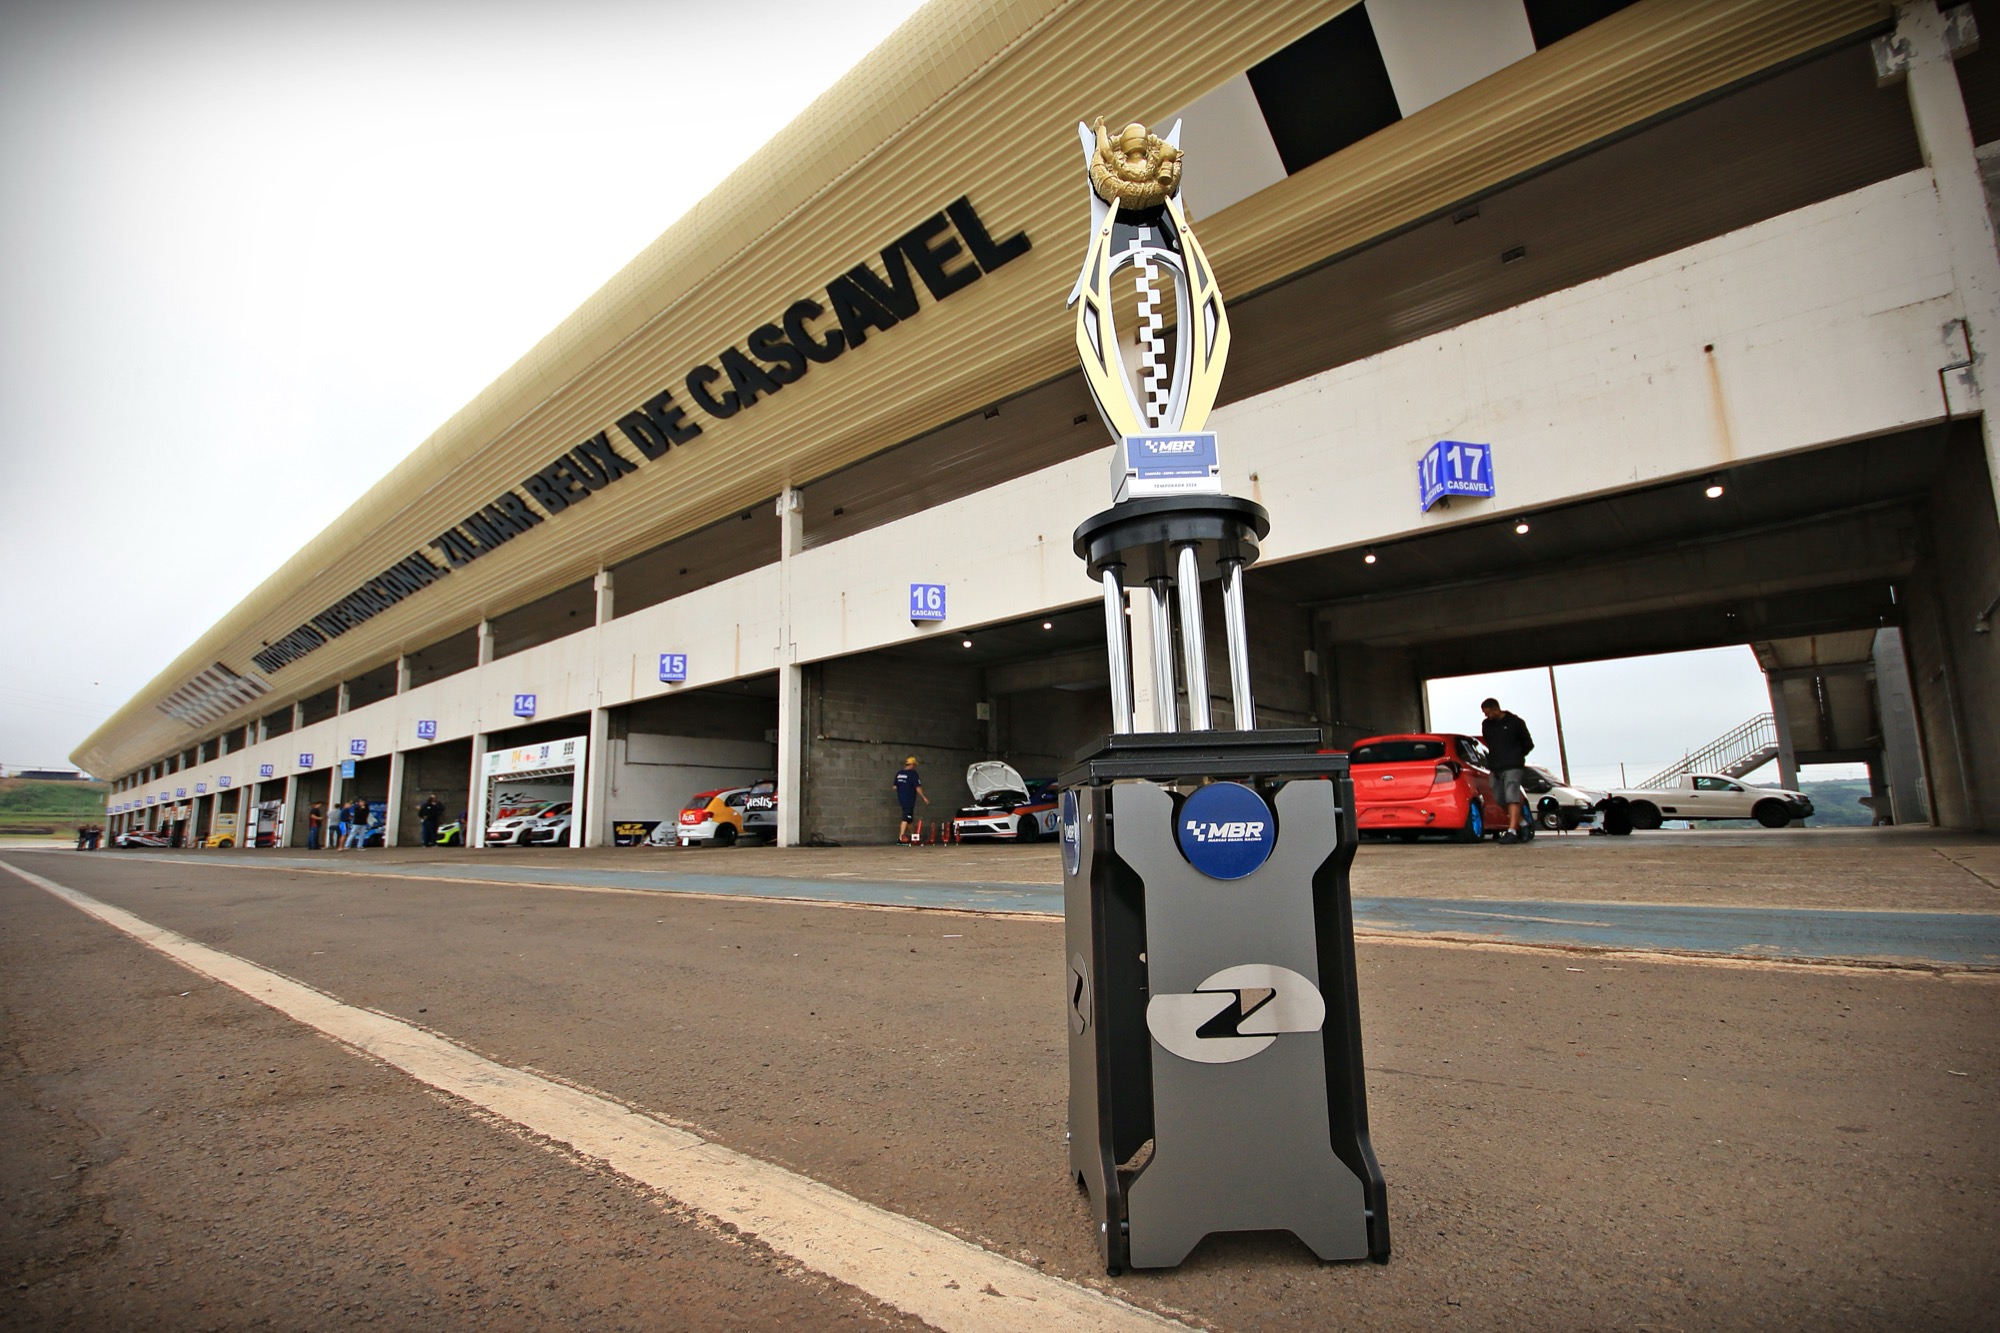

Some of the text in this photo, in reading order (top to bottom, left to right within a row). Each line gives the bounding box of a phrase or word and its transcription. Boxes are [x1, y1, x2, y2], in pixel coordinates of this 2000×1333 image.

[311, 550, 451, 639] INTERNACIONAL
[428, 490, 545, 569] ZILMAR
[521, 430, 639, 516] BEUX
[616, 389, 703, 462] DE
[686, 195, 1033, 420] CASCAVEL
[1159, 440, 1196, 452] MBR
[1447, 445, 1483, 480] 17
[1423, 448, 1439, 491] 17
[1447, 481, 1489, 492] CASCAVEL
[913, 586, 941, 610] 16
[662, 656, 684, 673] 15
[516, 696, 535, 710] 14
[419, 722, 435, 733] 13
[352, 741, 366, 750] 12
[301, 755, 313, 764] 11
[261, 765, 273, 774] 10
[220, 777, 231, 785] 09
[1208, 822, 1264, 838] MBR
